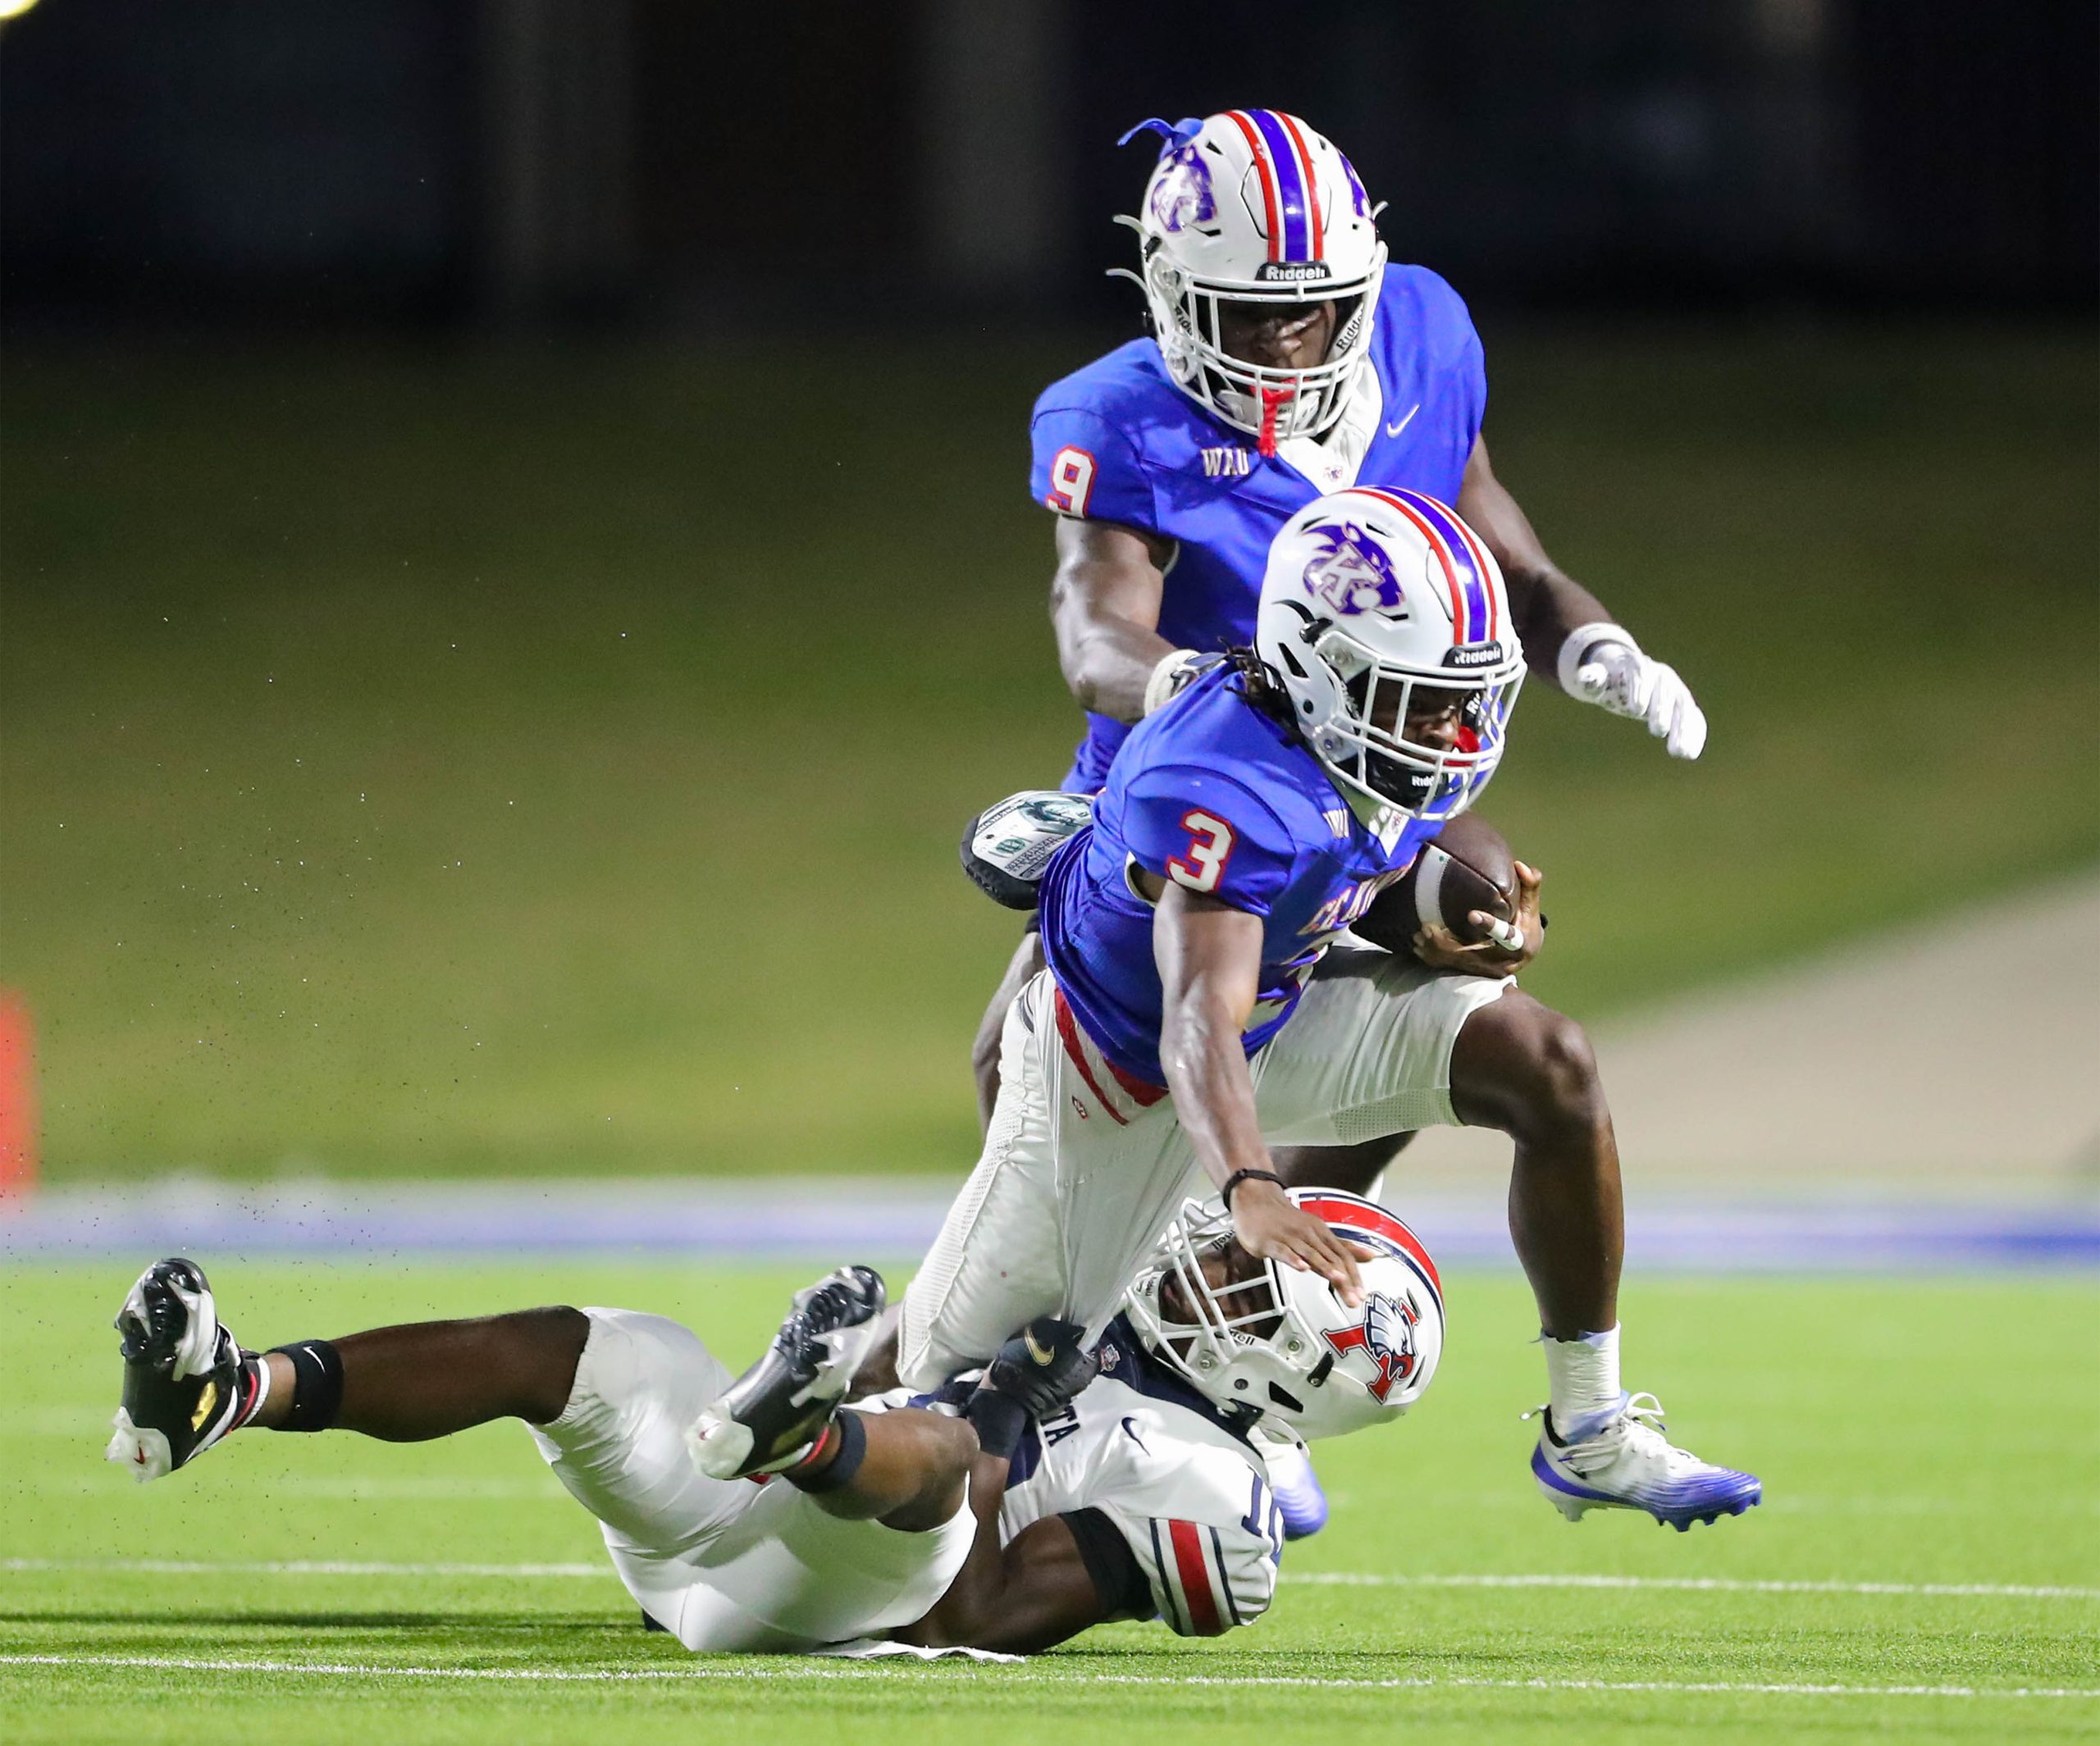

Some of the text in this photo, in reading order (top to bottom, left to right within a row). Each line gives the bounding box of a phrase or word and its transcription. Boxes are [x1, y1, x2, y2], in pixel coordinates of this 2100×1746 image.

[1266, 265, 1326, 280] Riddell
[1046, 444, 1098, 518] 9
[1165, 808, 1236, 894] 3
[1039, 1404, 1081, 1448] TA
